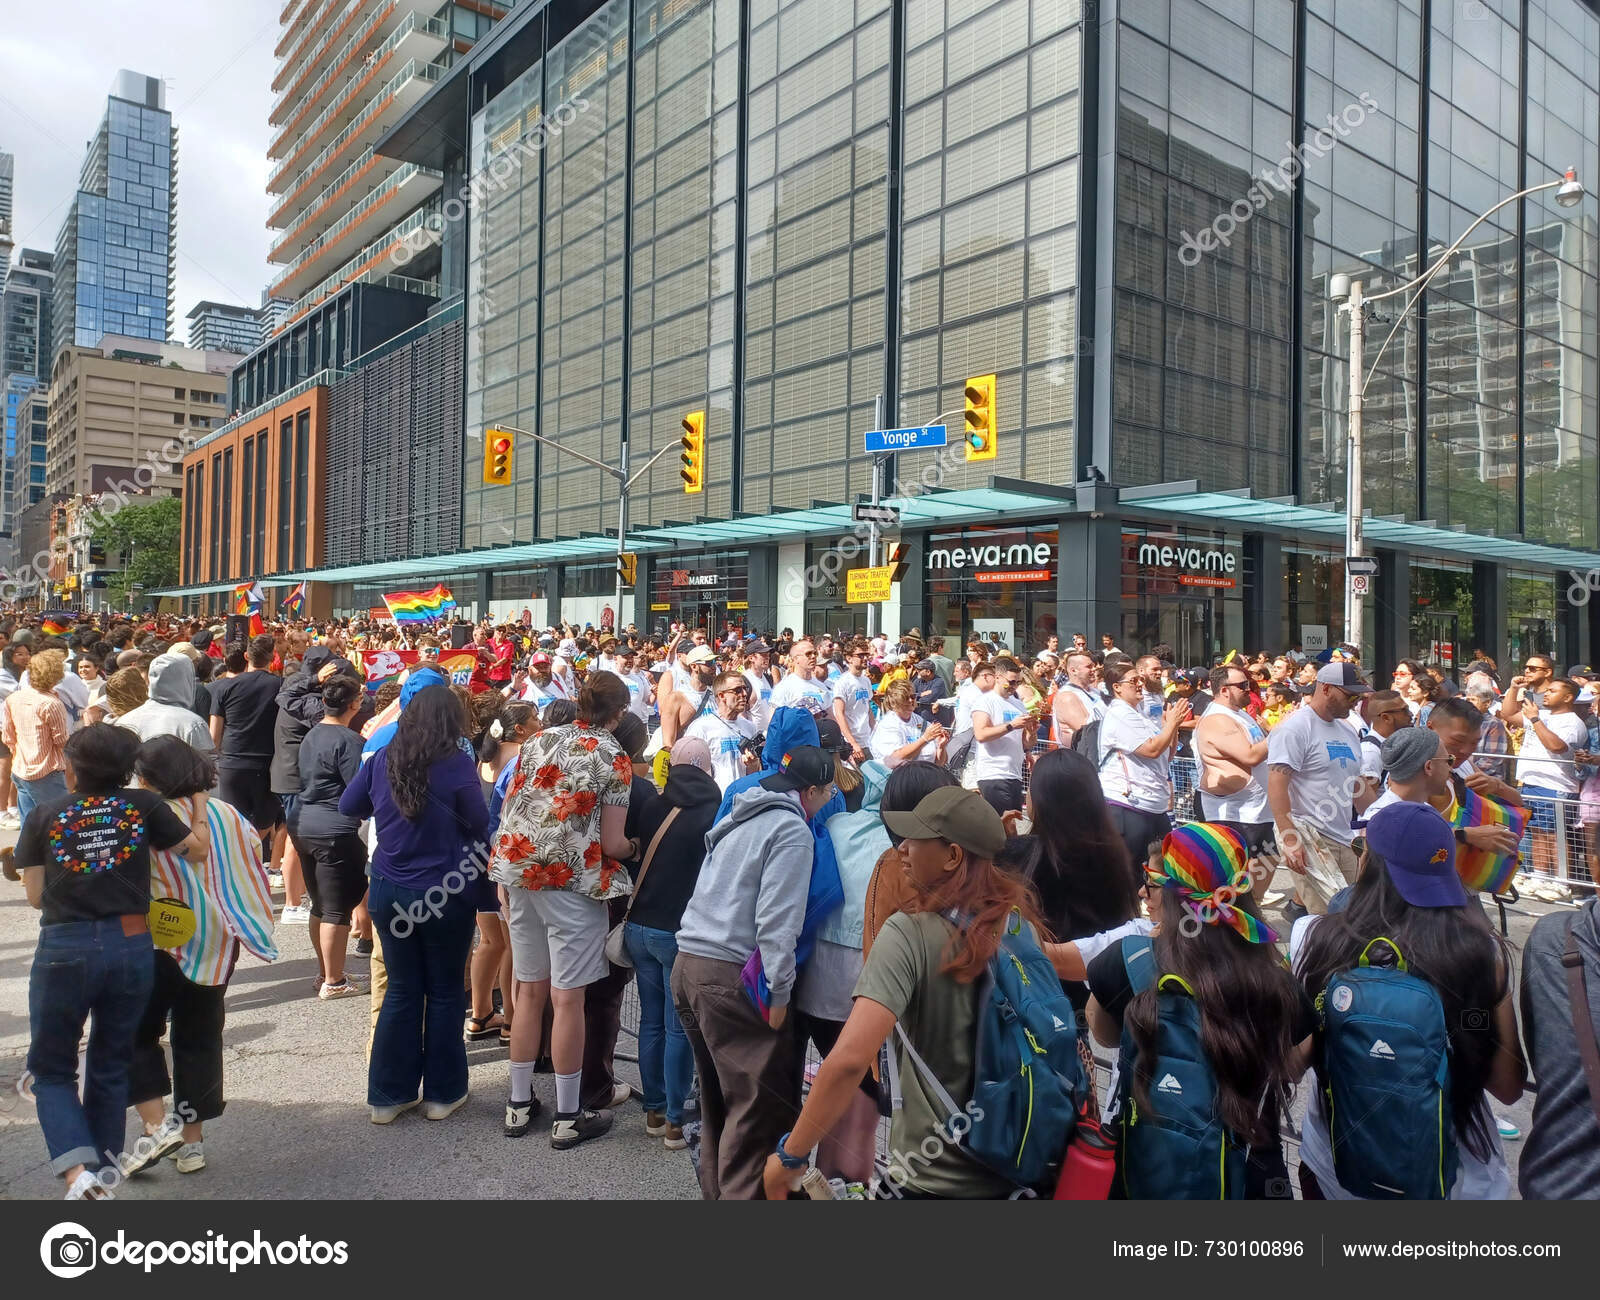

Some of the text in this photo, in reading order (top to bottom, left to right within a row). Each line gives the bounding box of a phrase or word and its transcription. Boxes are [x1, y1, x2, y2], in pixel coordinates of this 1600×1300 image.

[881, 431, 917, 446] Yonge
[689, 575, 718, 585] MARKET
[1306, 636, 1323, 645] now
[81, 807, 112, 816] ALWAYS
[64, 816, 129, 837] AUTHENTIC
[77, 828, 116, 838] TOGETHER
[76, 840, 118, 851] OURSELVES
[160, 911, 180, 923] fan
